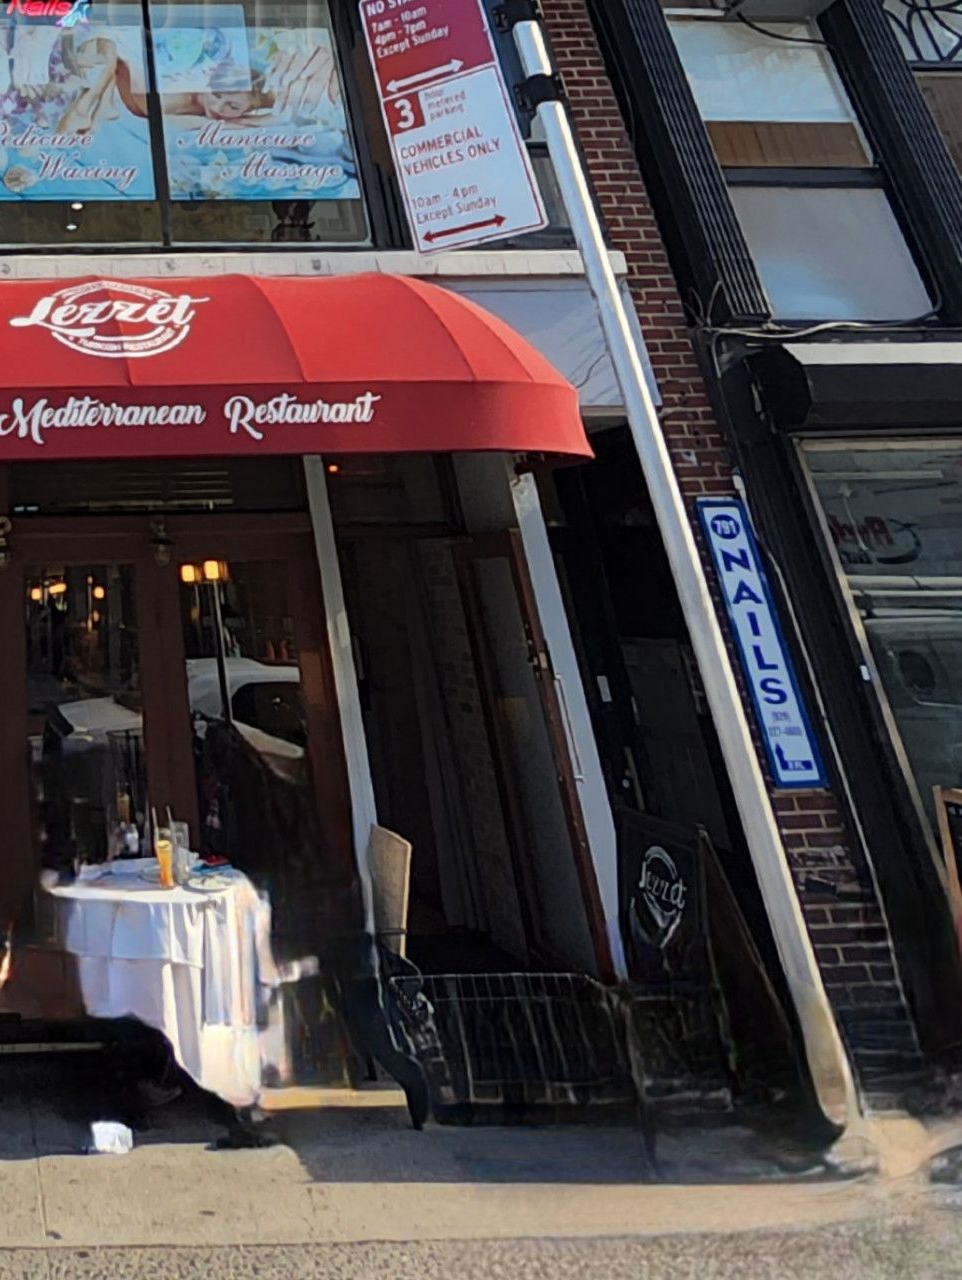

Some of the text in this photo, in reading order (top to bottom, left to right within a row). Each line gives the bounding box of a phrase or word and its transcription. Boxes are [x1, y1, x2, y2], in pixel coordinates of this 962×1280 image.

[366, 0, 385, 17] NO
[376, 25, 449, 58] Except Sunday
[395, 99, 415, 128] 3
[177, 121, 316, 149] Manicure
[401, 126, 483, 160] COMMERCIAL
[38, 152, 137, 189] Waxing
[222, 152, 343, 188] Massage
[403, 137, 501, 176] VEHICLES ONLY
[416, 195, 497, 225] Except Sunday
[10, 293, 210, 338] Lezzet
[225, 393, 382, 440] Restaurant
[714, 520, 737, 534] 791
[721, 548, 787, 705] NAILS
